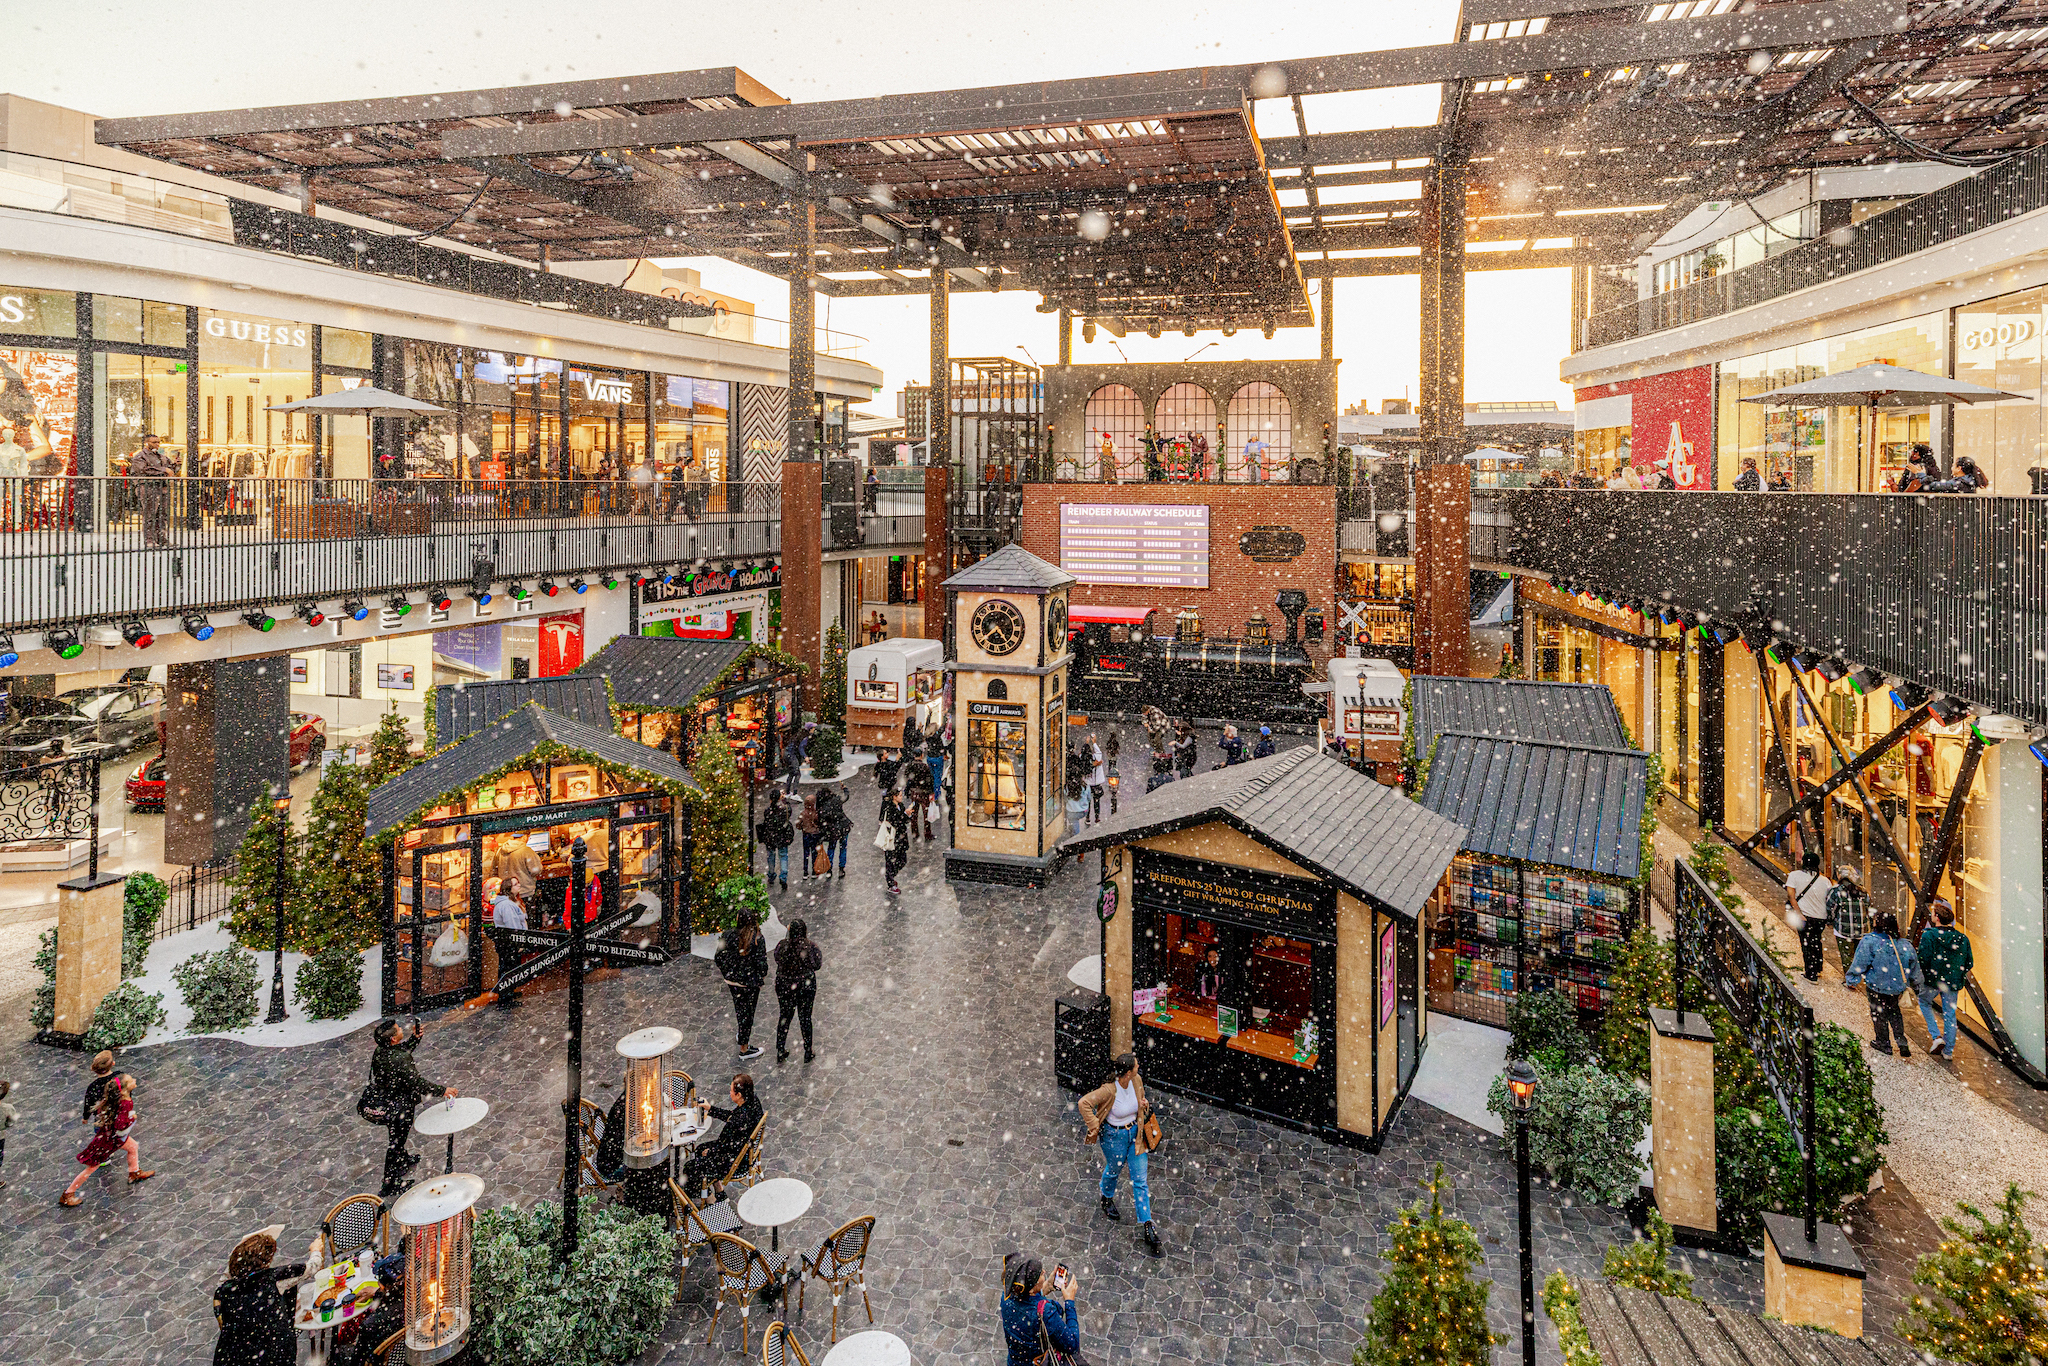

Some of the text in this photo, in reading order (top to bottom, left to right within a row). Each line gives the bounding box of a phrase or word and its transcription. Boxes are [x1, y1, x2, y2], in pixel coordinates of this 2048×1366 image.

[205, 317, 306, 347] GUESS
[1963, 320, 2033, 350] GOOD
[583, 378, 633, 404] VANS
[1067, 507, 1203, 518] REINDEER RAILWAY SCHEDULE
[693, 572, 733, 596] GRINCH
[739, 568, 773, 587] HOLIDAY
[982, 704, 1000, 715] FIJI
[526, 811, 568, 823] POP MART
[1150, 872, 1314, 912] FREEFORM'S 25 DAYS OF CHRISTMAS
[1183, 889, 1280, 915] GIFT WRAPPING STATION
[610, 912, 633, 932] SQUARE
[511, 934, 558, 947] THE GRINCH
[586, 943, 664, 962] UP TO BLITZEN'S BAR
[499, 946, 571, 992] SANTA'S BUNGALOW
